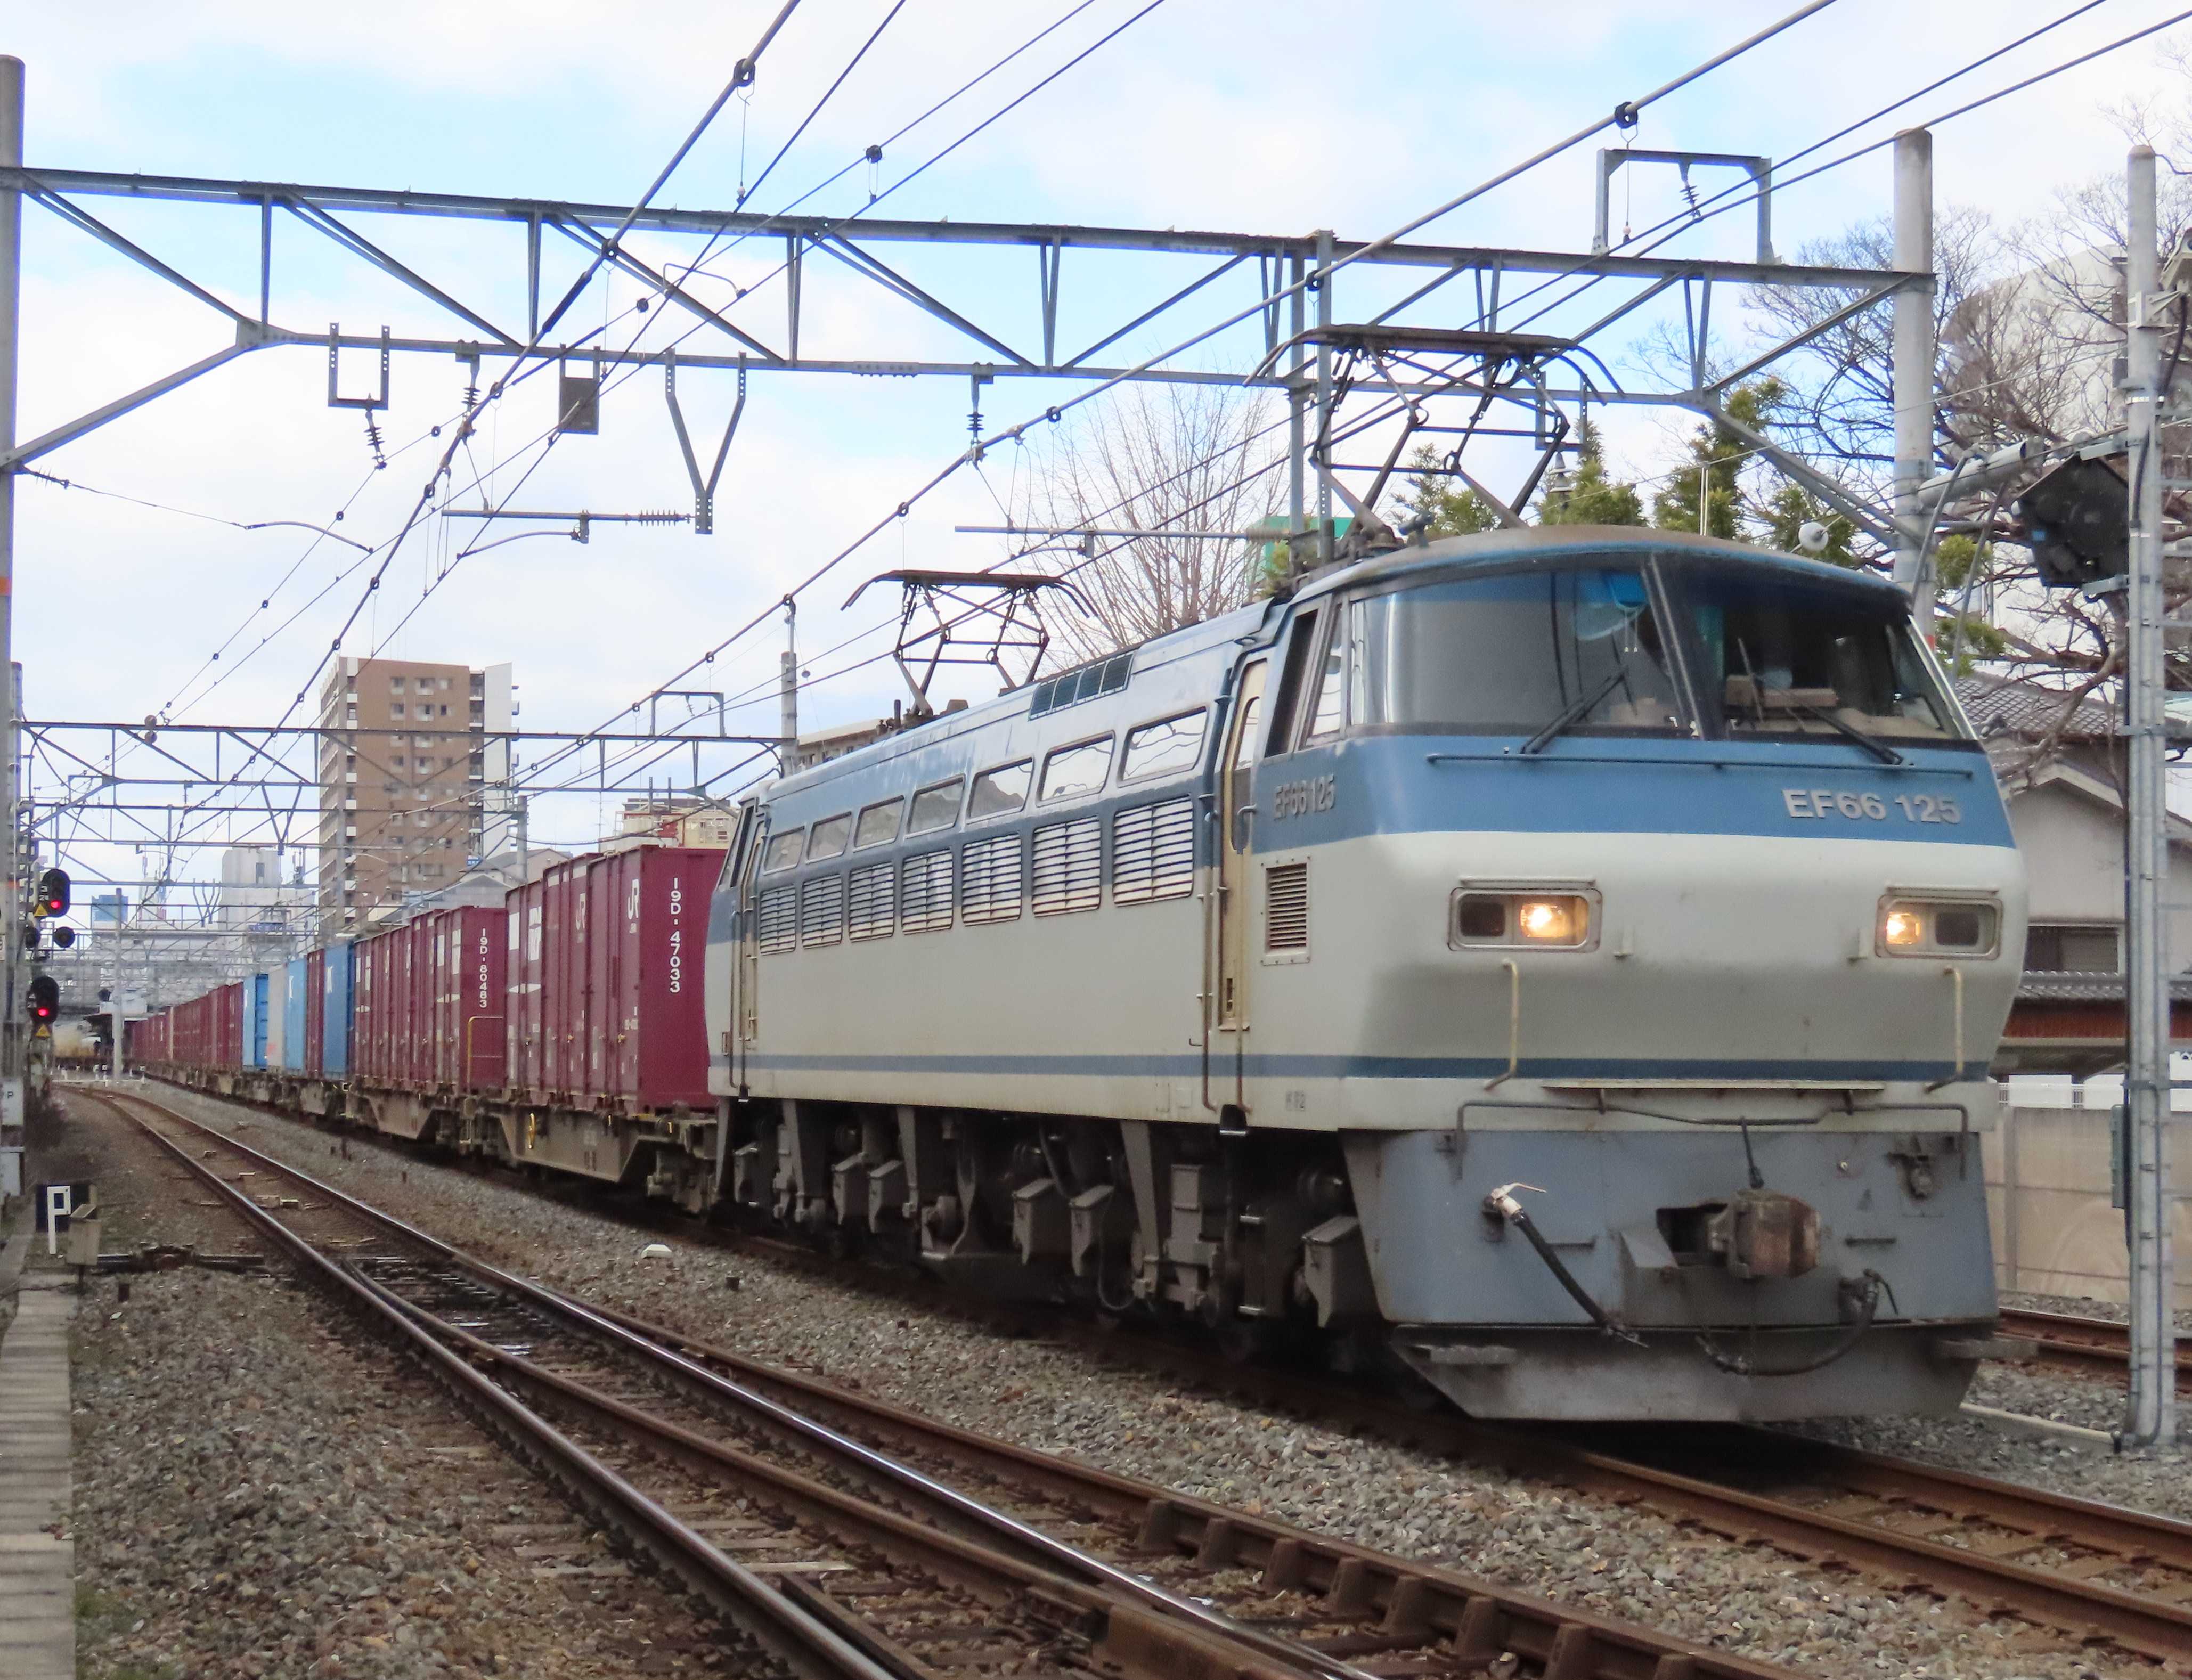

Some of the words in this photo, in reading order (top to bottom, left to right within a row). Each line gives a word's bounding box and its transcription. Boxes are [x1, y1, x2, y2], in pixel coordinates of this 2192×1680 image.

[1274, 780, 1307, 820] EF66
[1311, 774, 1335, 813] 125
[1782, 789, 1887, 820] EF66
[1894, 794, 1961, 824] 125
[576, 893, 586, 931] JR
[628, 879, 639, 920] JR
[46, 1185, 71, 1255] P
